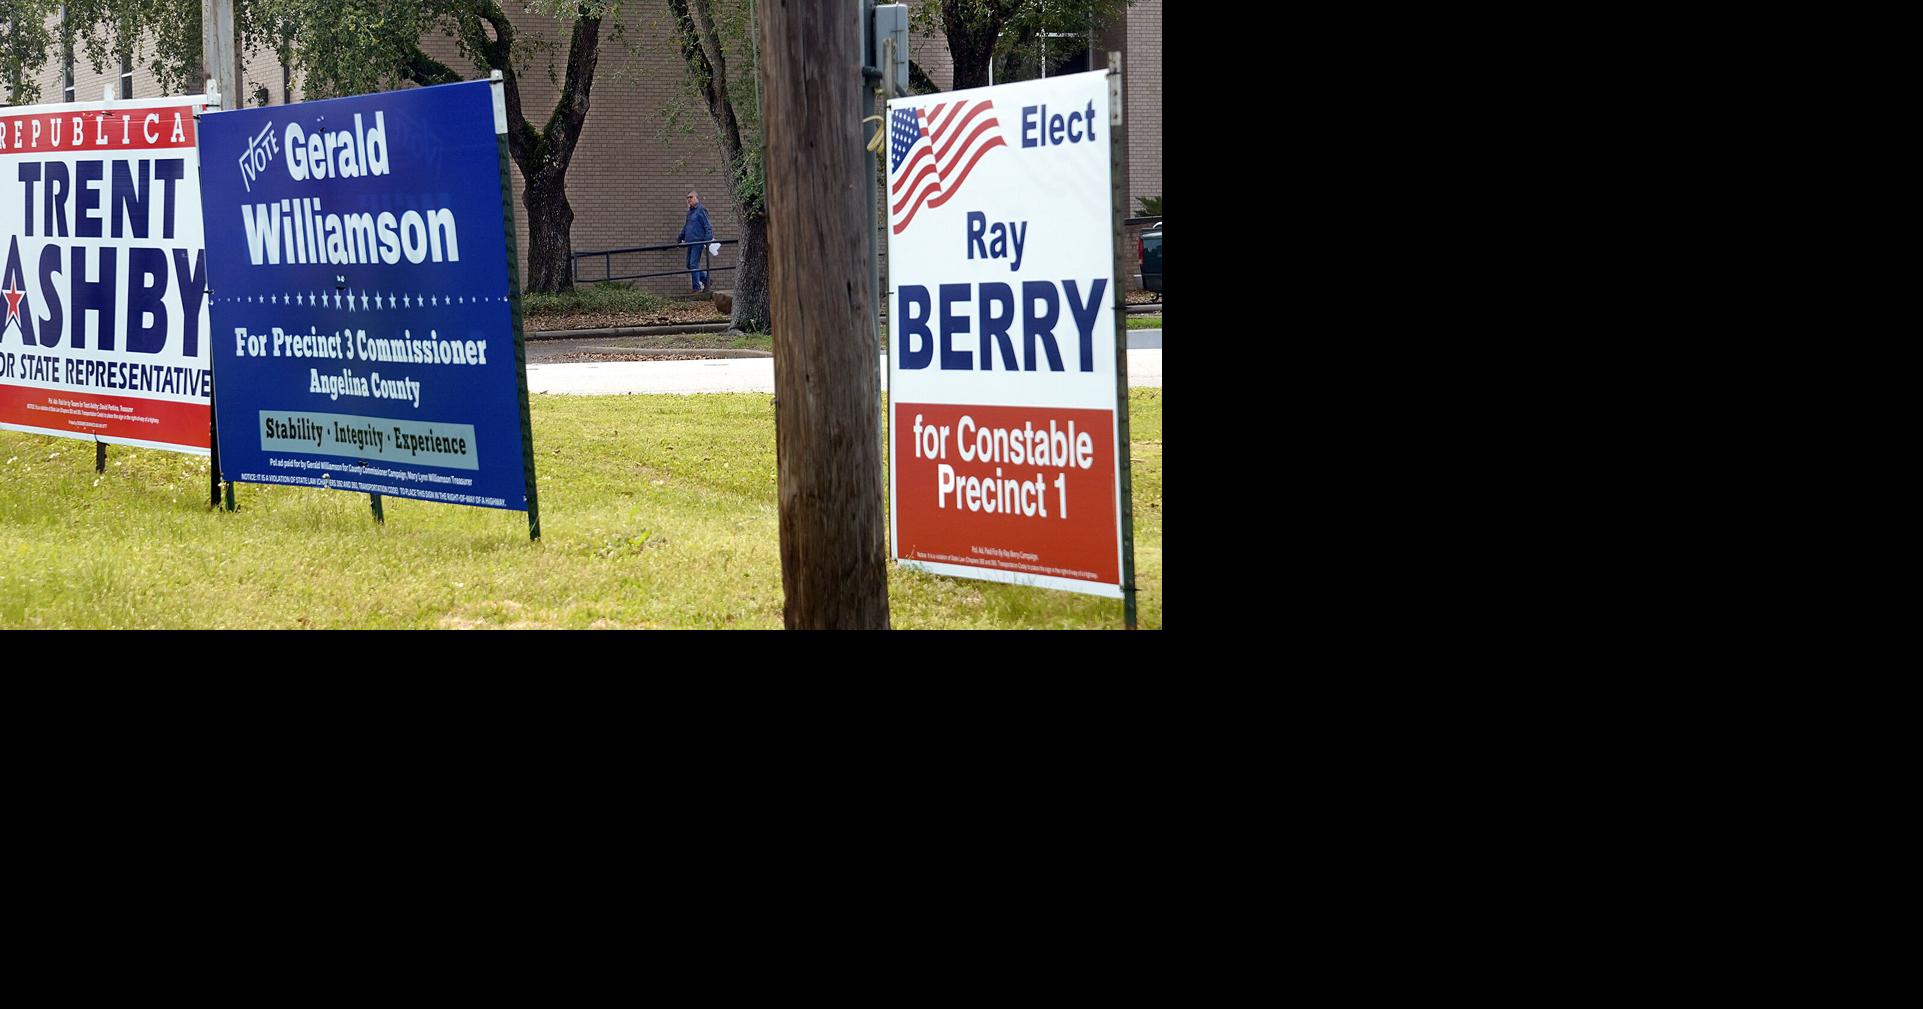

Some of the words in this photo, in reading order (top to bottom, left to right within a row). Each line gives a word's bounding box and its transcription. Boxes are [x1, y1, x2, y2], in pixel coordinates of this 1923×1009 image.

[284, 110, 390, 182] Gerald
[1021, 99, 1096, 149] Elect
[243, 129, 280, 183] VOTE
[18, 158, 185, 240] TRENT
[241, 197, 459, 266] Williamson
[966, 210, 1028, 272] Ray
[0, 234, 207, 358] ASHBY
[234, 327, 267, 357] For
[271, 326, 343, 359] Precinct
[344, 328, 354, 360] 3
[356, 329, 487, 365] Commissioner
[897, 278, 1109, 373] BERRY
[20, 353, 60, 383] STATE
[65, 358, 211, 398] REPRESENTATIVE
[310, 368, 369, 401] Angelina
[371, 371, 420, 408] County
[266, 416, 323, 447] Stability
[334, 420, 384, 452] Integrity
[395, 426, 466, 456] Experience
[913, 413, 950, 460] for
[957, 415, 1094, 470] Constable
[937, 463, 1047, 518] Precinct
[1054, 472, 1067, 519] 1
